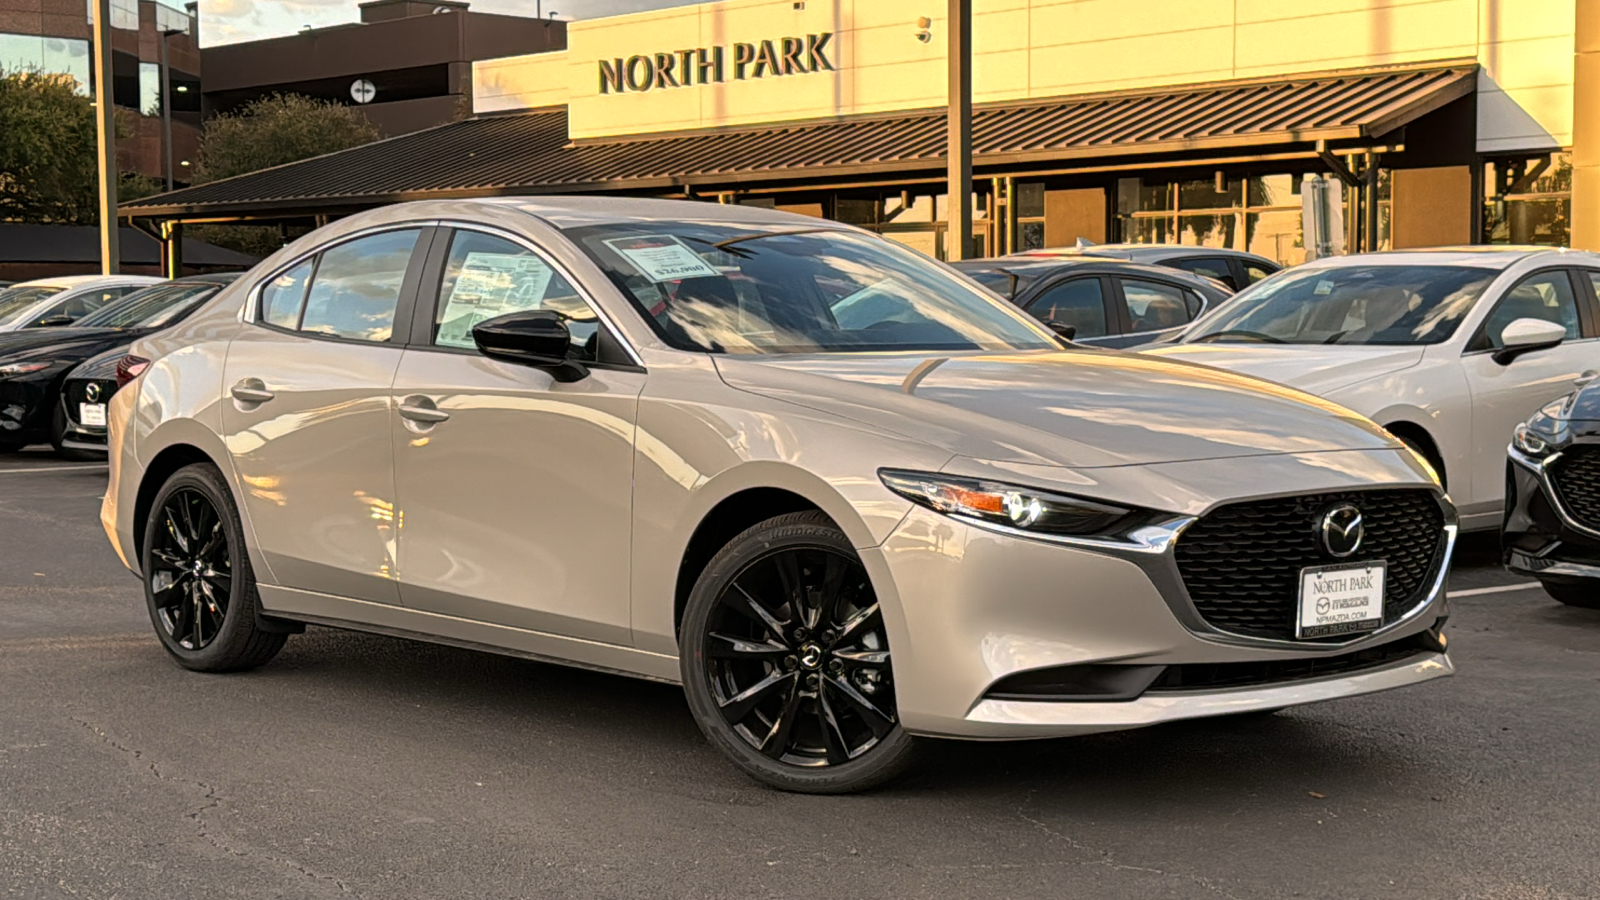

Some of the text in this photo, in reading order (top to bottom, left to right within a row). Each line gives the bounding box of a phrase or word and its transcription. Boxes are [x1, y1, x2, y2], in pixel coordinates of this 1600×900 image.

[599, 33, 836, 94] NORTH PARK
[771, 527, 846, 541] BRIDGESTO
[1313, 576, 1373, 594] NORTH PARK
[1332, 596, 1369, 610] mazda
[1316, 611, 1367, 624] NPMAZDA.COM
[1304, 626, 1328, 637] NORTH
[1329, 624, 1348, 634] PARK
